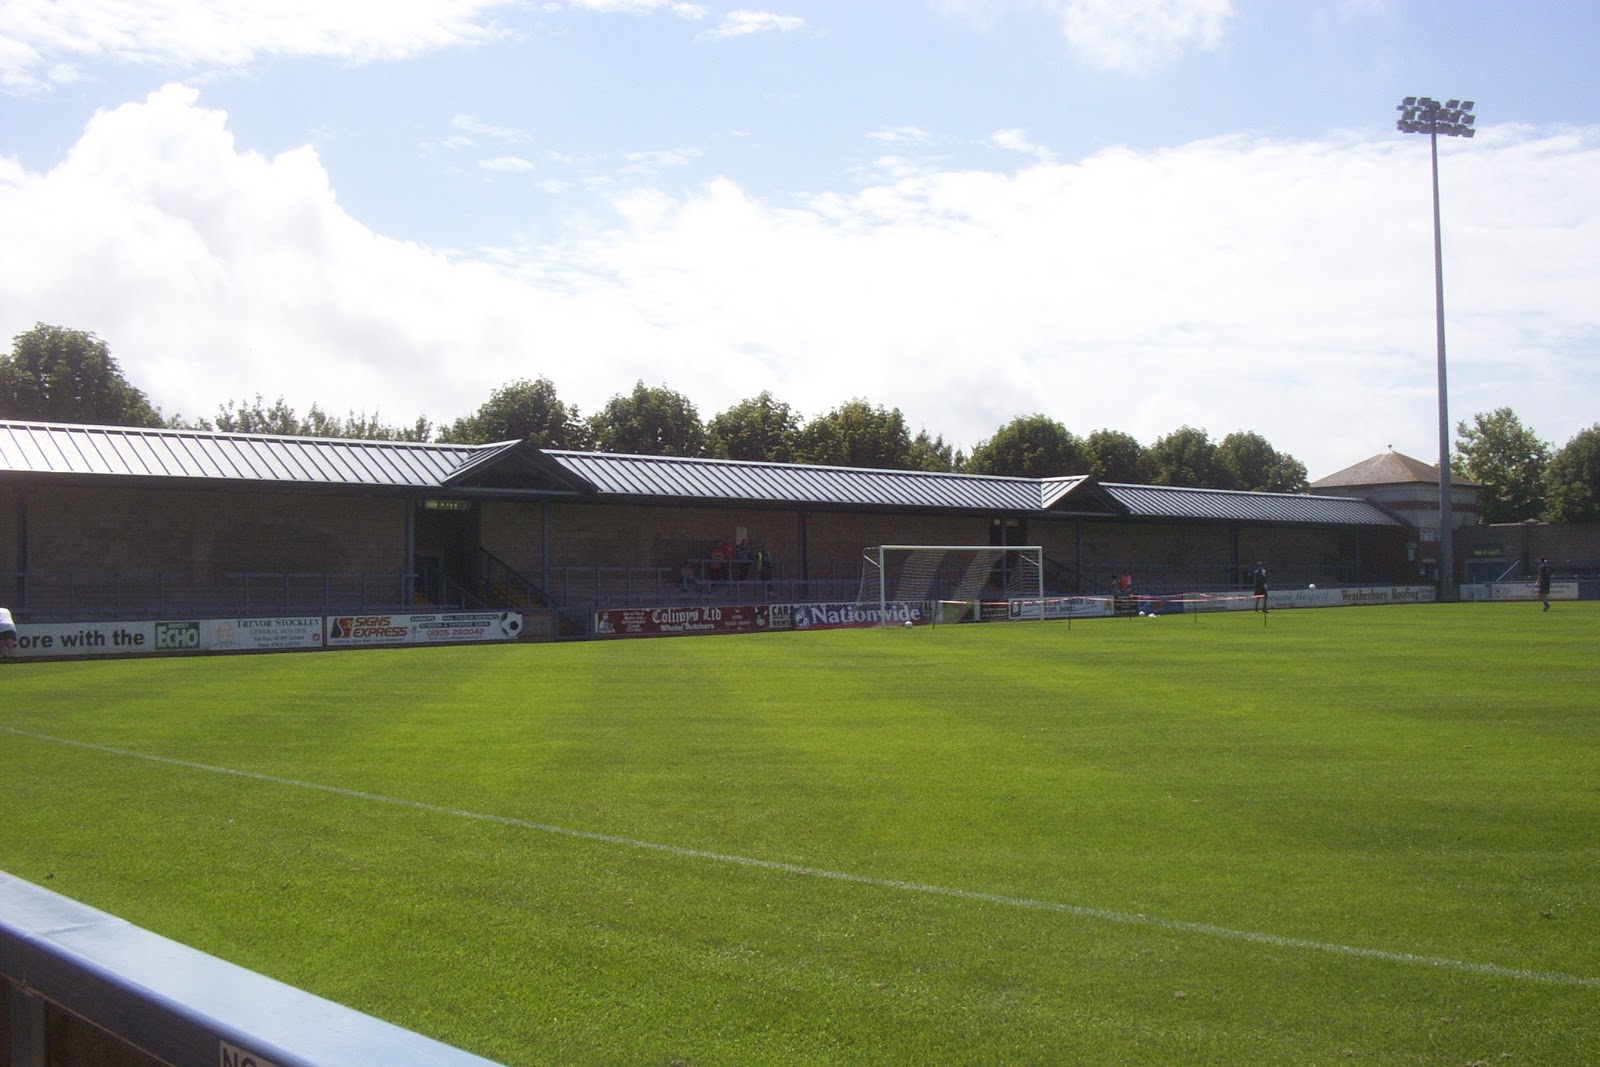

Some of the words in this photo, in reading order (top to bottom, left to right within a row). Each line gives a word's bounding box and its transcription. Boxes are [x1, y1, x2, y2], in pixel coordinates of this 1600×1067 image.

[1296, 590, 1329, 602] Hospital
[1341, 588, 1388, 601] Weatherbury
[1391, 587, 1418, 600] Roofing
[702, 606, 722, 621] Ltd
[810, 604, 921, 624] Nationwide
[237, 619, 272, 628] TREVOR
[275, 618, 320, 627] STOCKLEY
[355, 616, 391, 626] SIGNS
[685, 622, 715, 630] Butchers
[60, 630, 106, 648] with
[112, 629, 145, 646] the
[157, 626, 199, 648] ECHO
[353, 627, 408, 638] EXPRESS
[427, 629, 449, 637] 01305
